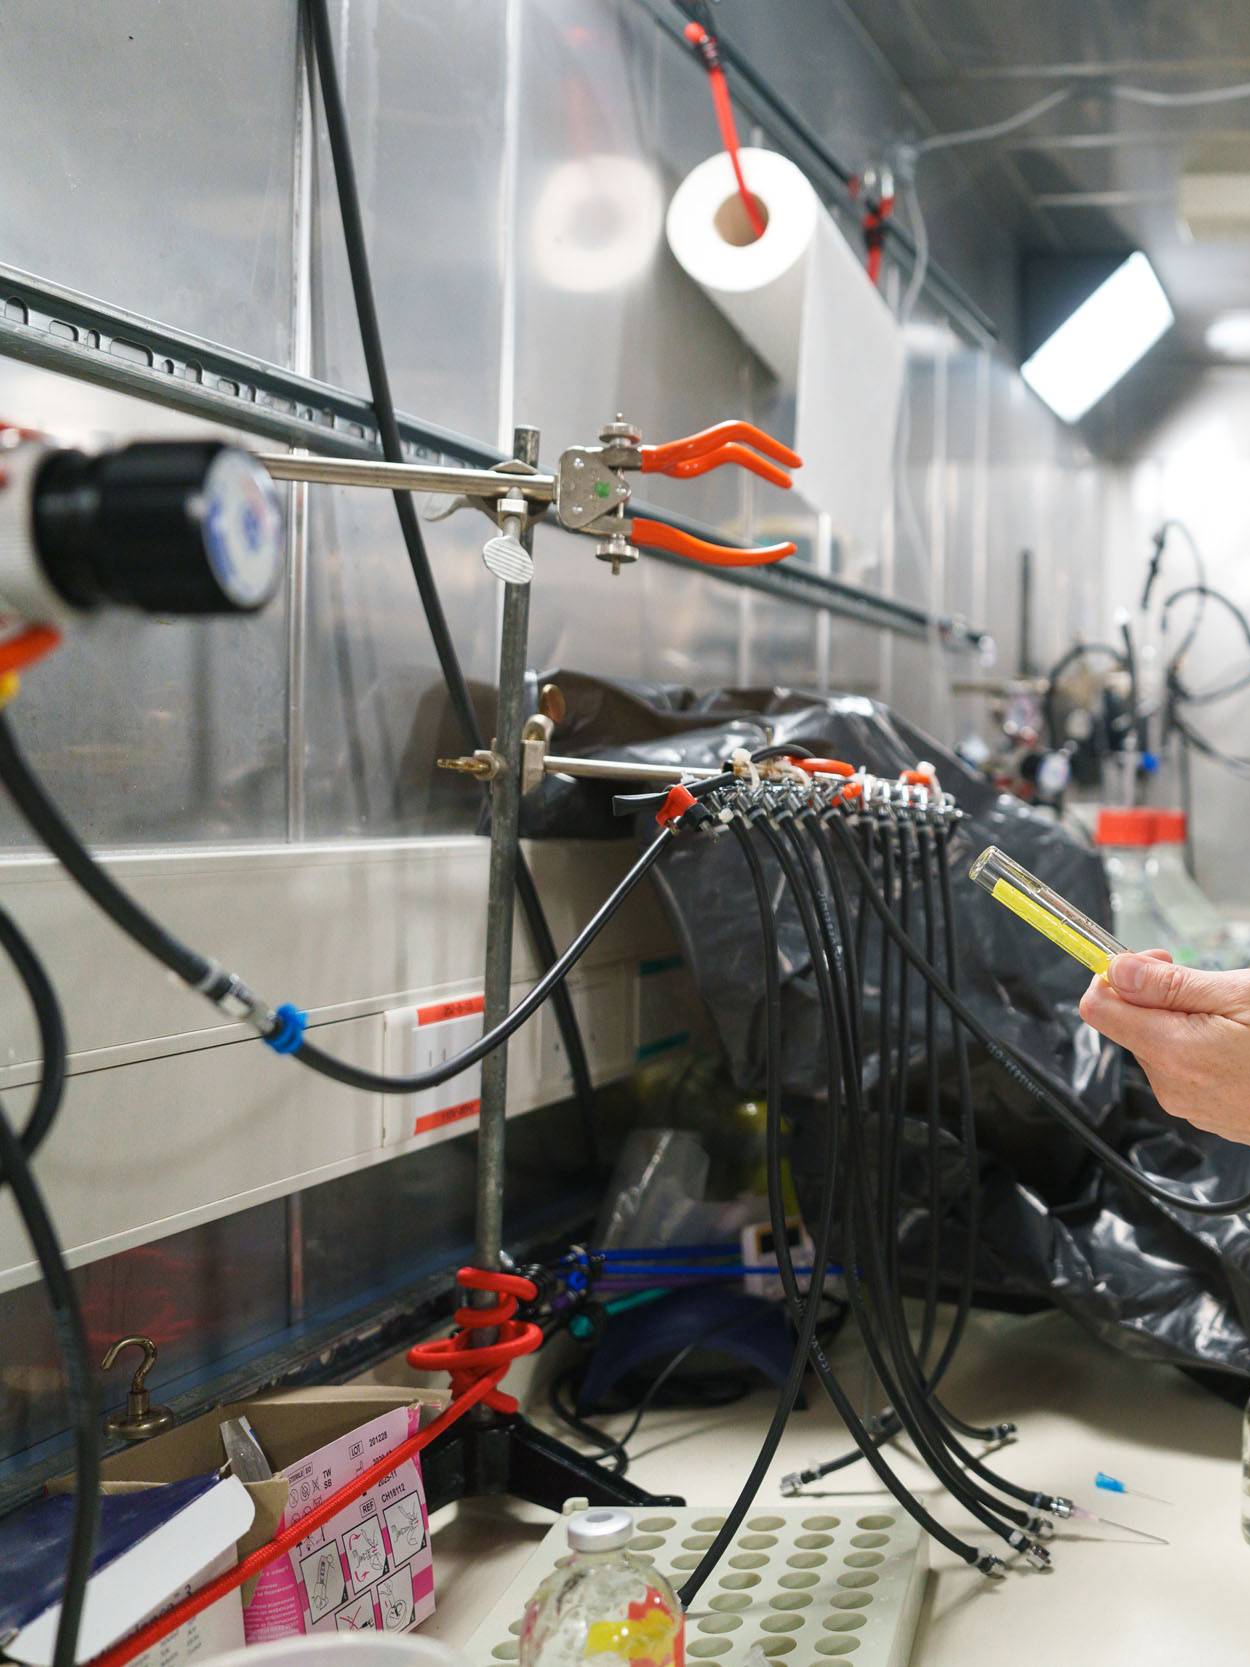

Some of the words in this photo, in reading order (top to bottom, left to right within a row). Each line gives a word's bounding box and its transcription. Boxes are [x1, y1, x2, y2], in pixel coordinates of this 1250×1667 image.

[350, 1443, 361, 1457] LOT
[322, 1467, 332, 1478] TW
[324, 1479, 332, 1490] SB
[362, 1501, 374, 1513] REF
